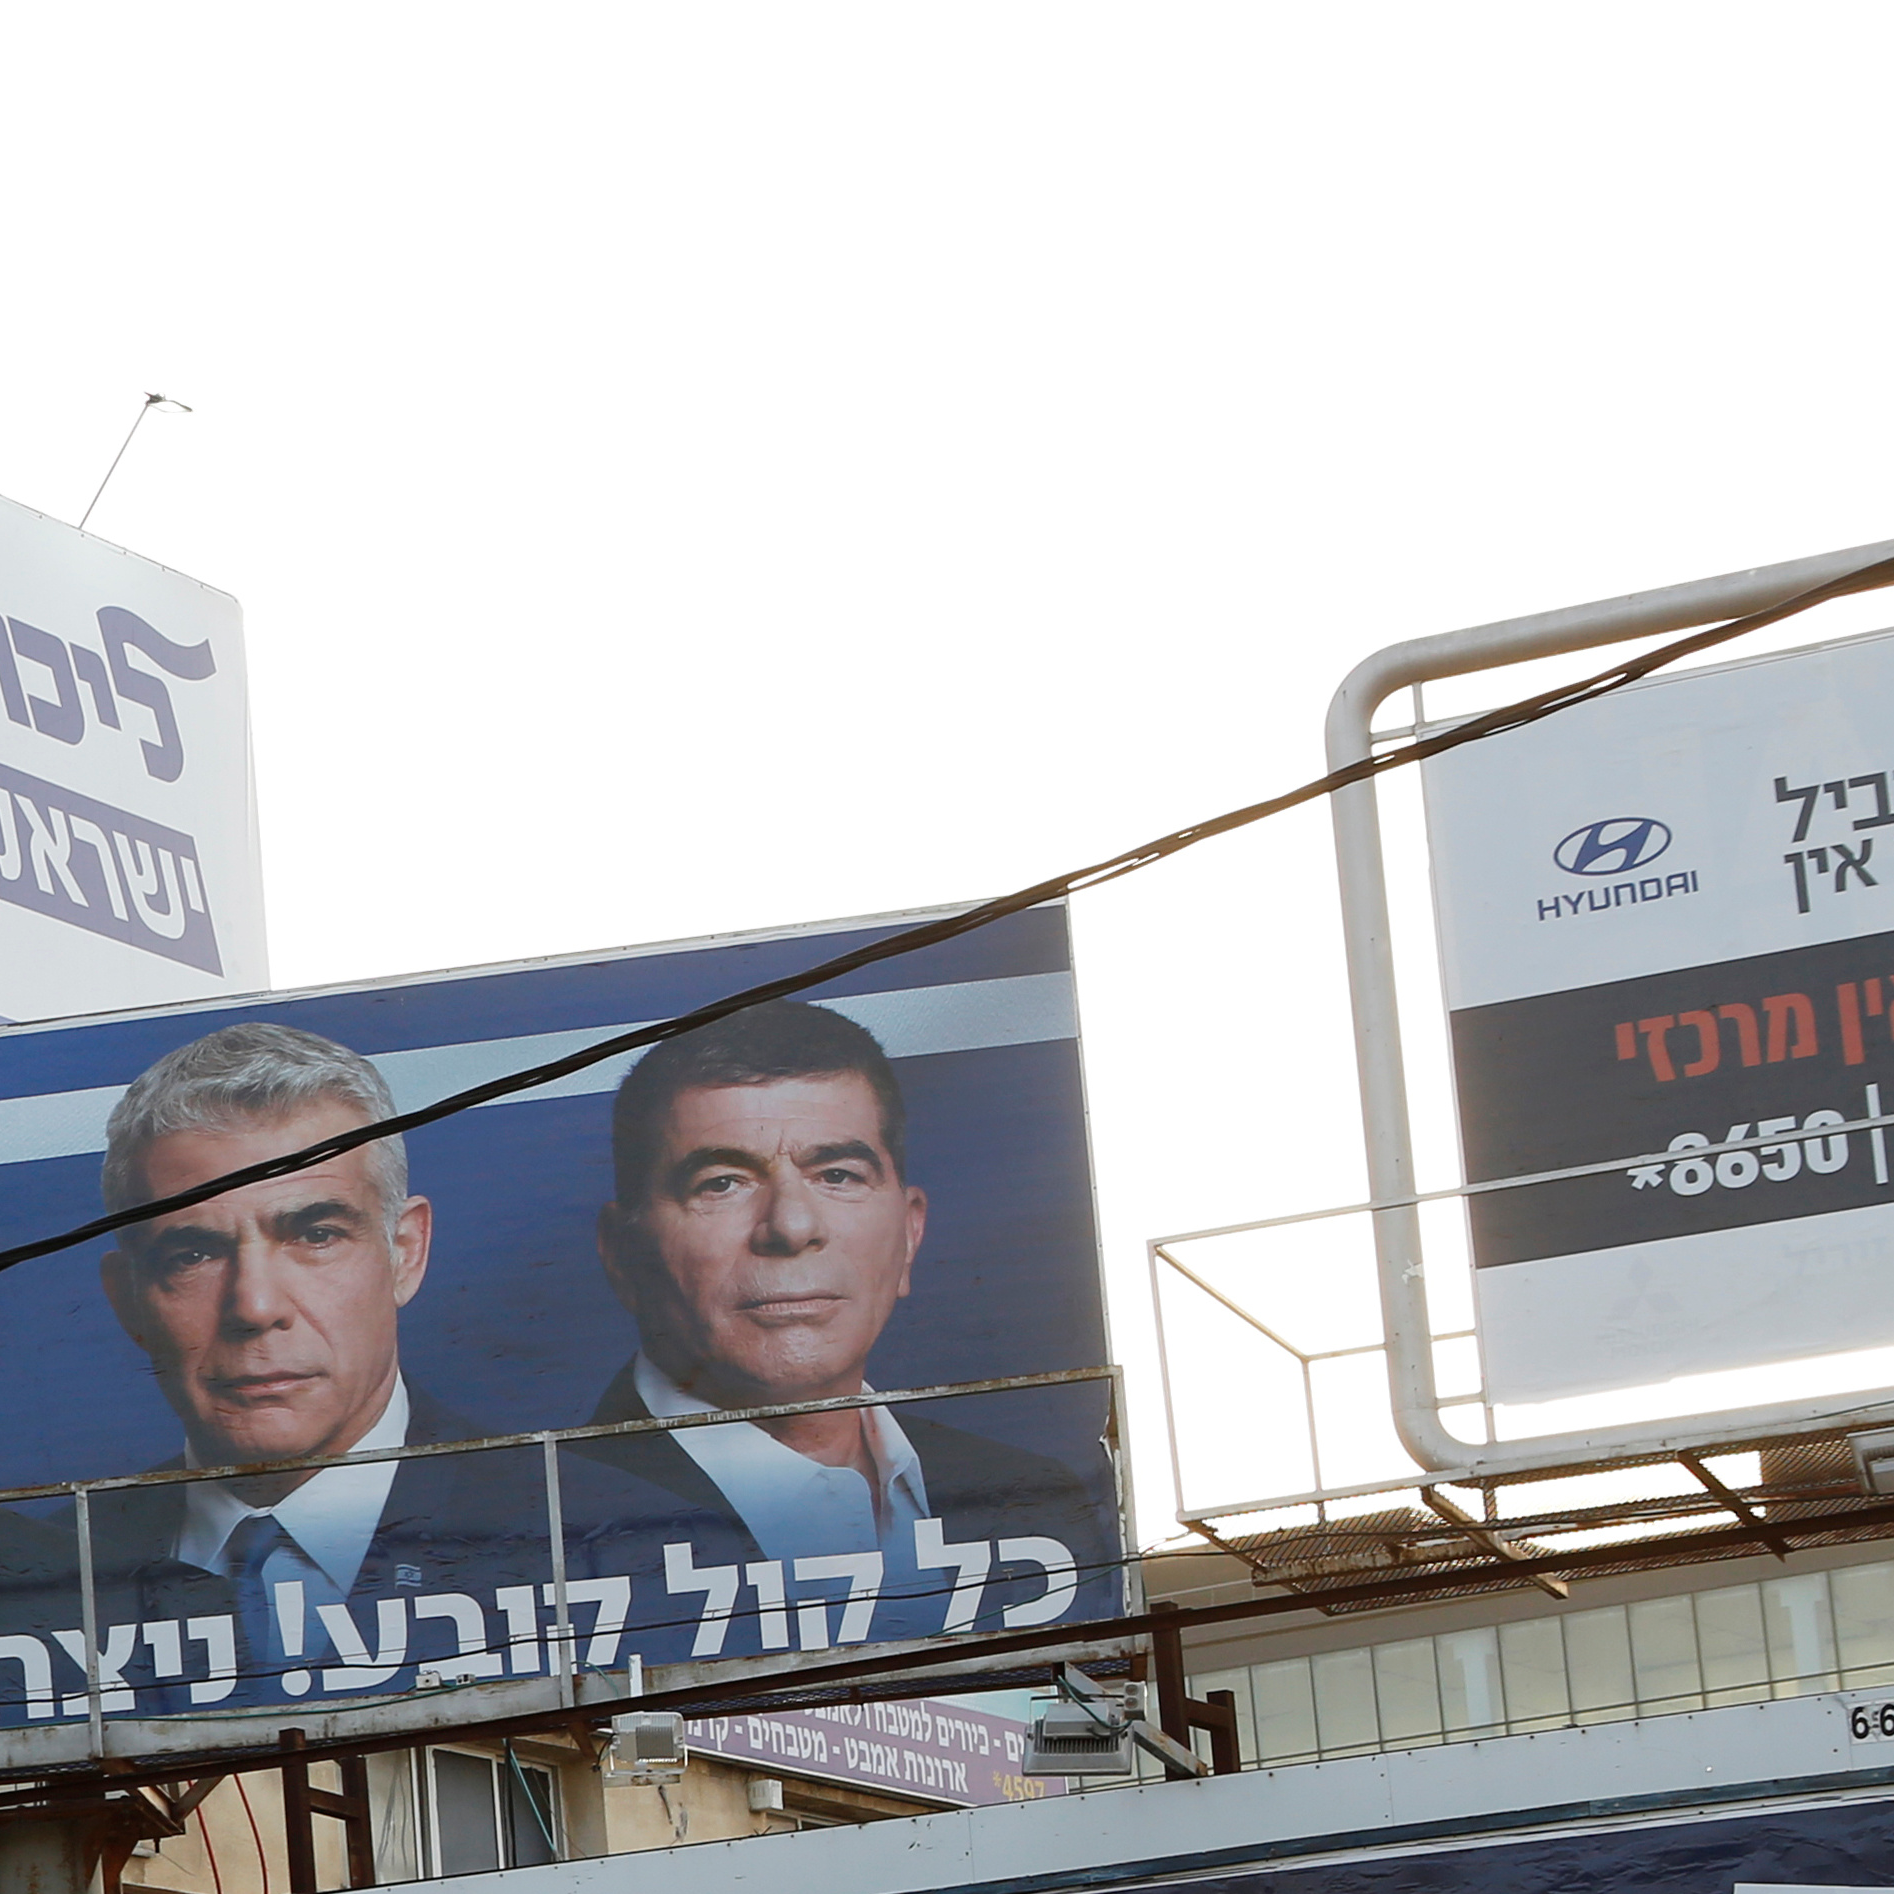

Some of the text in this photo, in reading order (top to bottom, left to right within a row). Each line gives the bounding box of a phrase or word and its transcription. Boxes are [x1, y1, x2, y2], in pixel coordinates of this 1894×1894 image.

[1538, 870, 1699, 922] HYUNDAI
[1784, 838, 1879, 914] אין
[1615, 993, 1819, 1082] מרכזי
[663, 1541, 882, 1658] קול
[913, 1518, 1078, 1632] כל
[278, 1574, 631, 1698] קובע!
[747, 1716, 828, 1763] מטבחים
[844, 1737, 900, 1778] אמבט
[874, 1701, 933, 1743] למטבח
[936, 1715, 990, 1756] כיורים
[903, 1750, 969, 1793] ארונות
